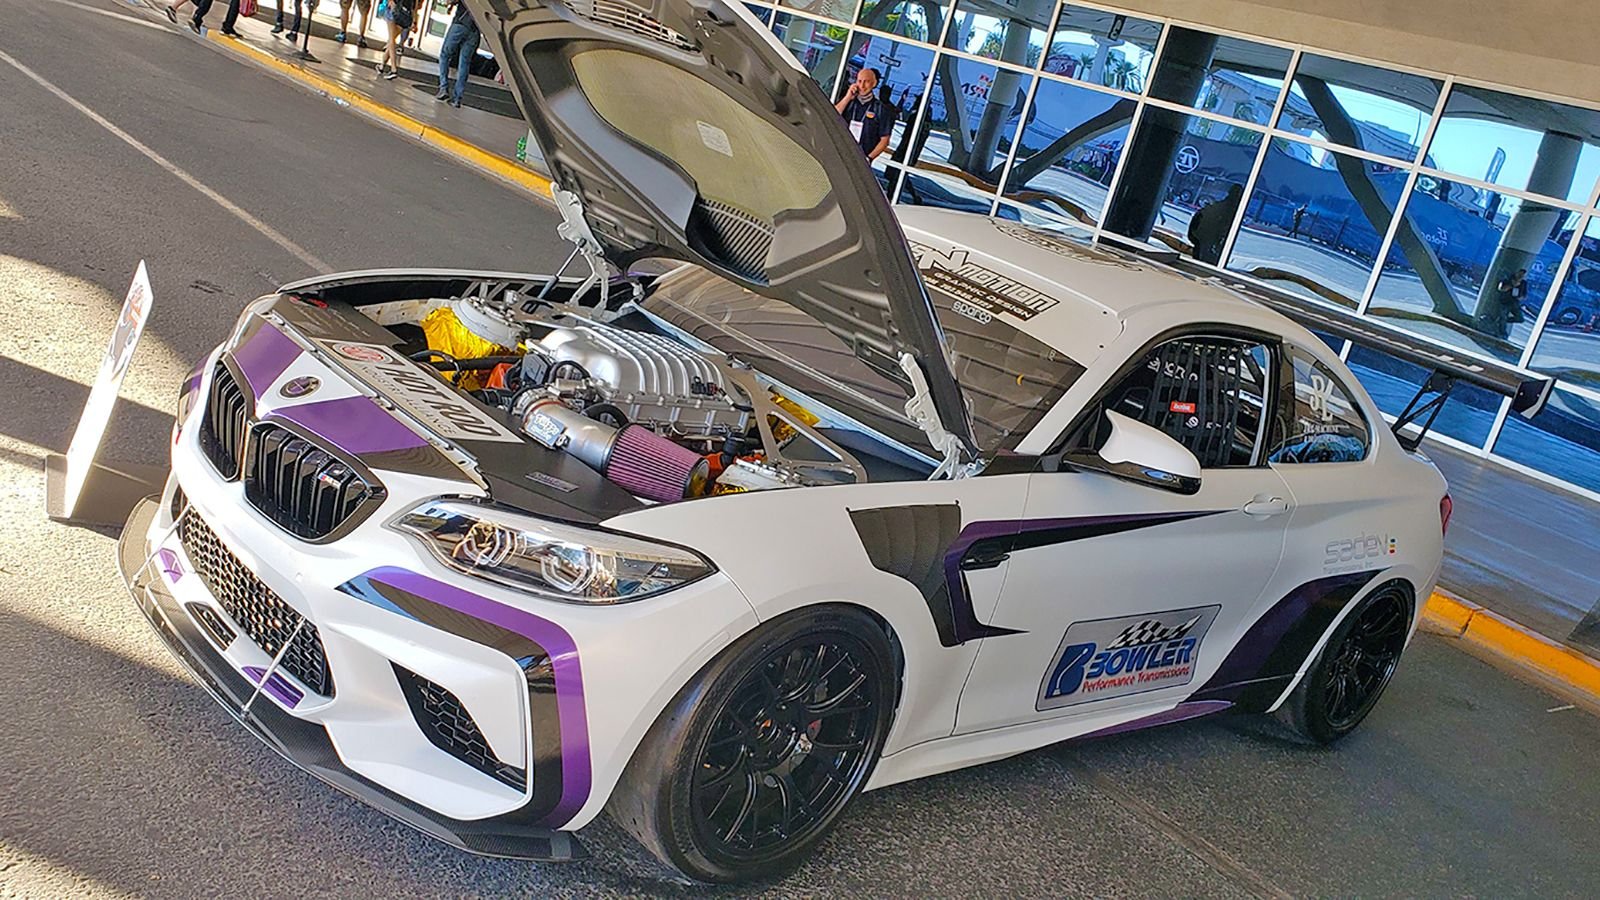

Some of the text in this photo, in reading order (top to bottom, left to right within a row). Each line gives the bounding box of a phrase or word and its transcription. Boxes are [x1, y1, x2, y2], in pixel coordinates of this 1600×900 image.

[934, 272, 1032, 318] GRAPHIC DESIGN
[951, 301, 992, 325] sparco
[375, 365, 453, 401] HOT
[422, 398, 502, 437] ROD
[1085, 636, 1192, 679] BOWLER
[1082, 666, 1190, 693] Performance Transmissions
